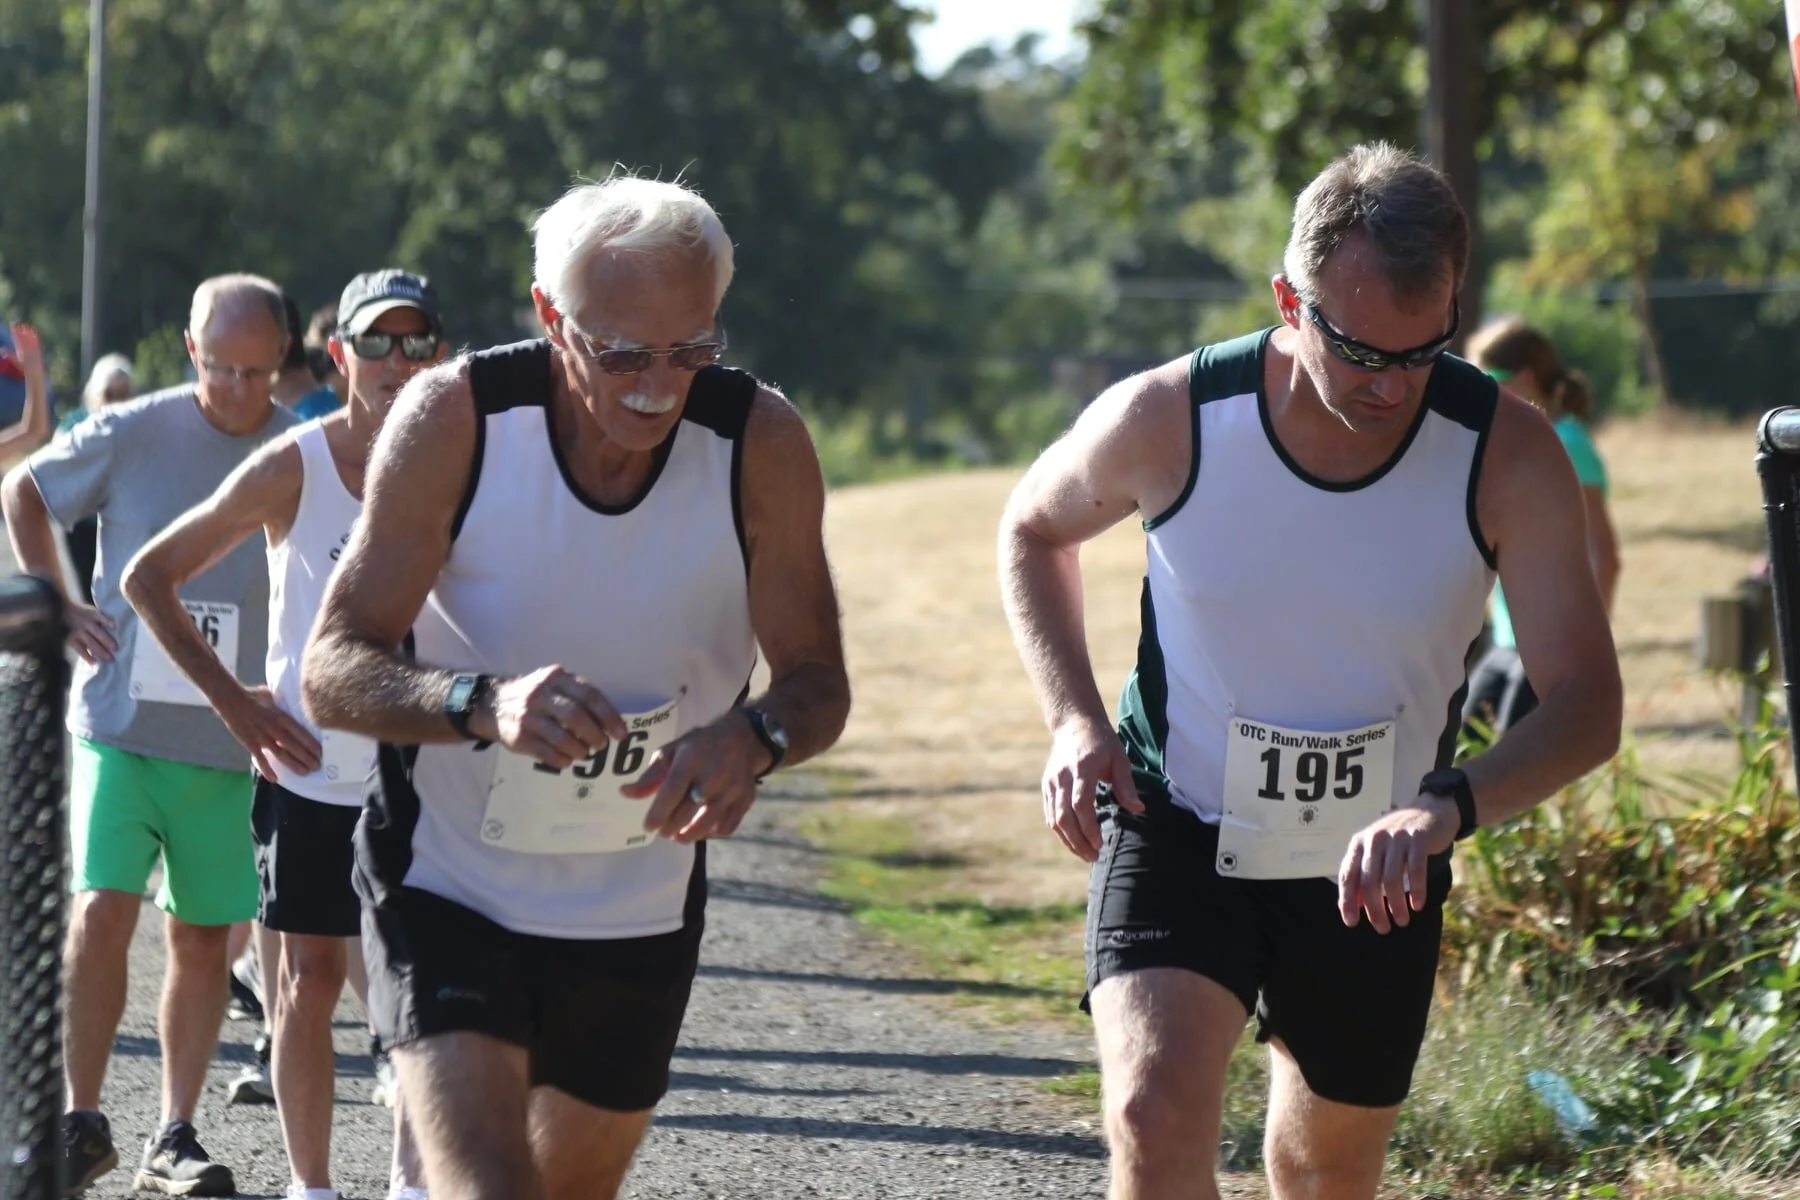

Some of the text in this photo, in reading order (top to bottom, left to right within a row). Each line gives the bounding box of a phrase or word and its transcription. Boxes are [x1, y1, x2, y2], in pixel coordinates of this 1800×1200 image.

[191, 614, 219, 647] 6
[631, 709, 671, 729] Series
[1240, 723, 1386, 750] OTC Run/Walk Series
[533, 730, 649, 779] 96
[1257, 747, 1366, 803] 195
